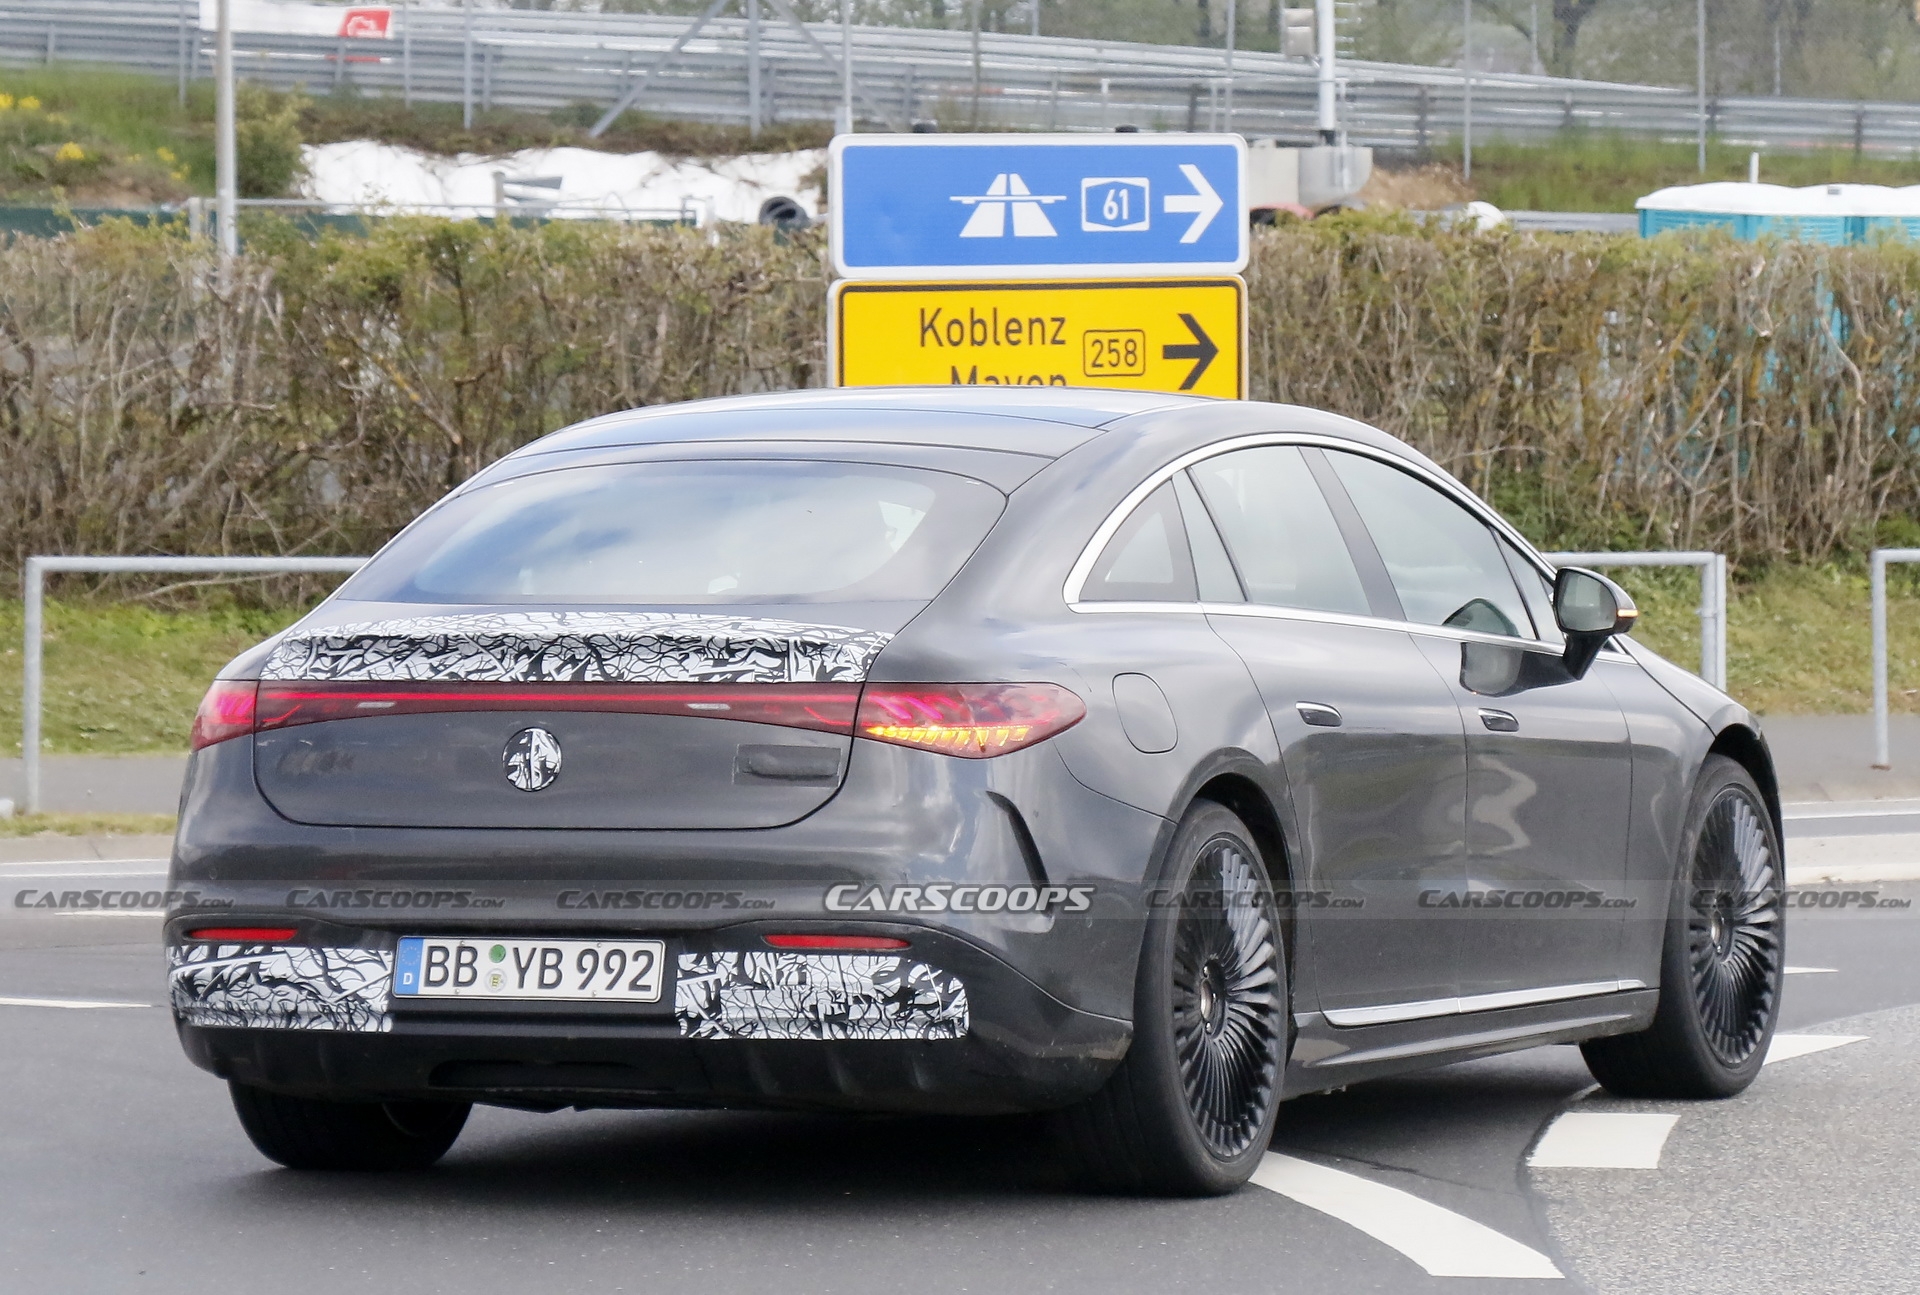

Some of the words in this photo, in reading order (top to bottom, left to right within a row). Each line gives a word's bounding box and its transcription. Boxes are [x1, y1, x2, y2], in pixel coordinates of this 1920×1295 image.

[1103, 188, 1129, 220] 61
[919, 307, 1067, 347] Koblenz
[1090, 338, 1139, 369] 258
[402, 972, 414, 986] D
[423, 945, 479, 989] BB
[512, 947, 563, 991] YB
[575, 948, 656, 993] 992
